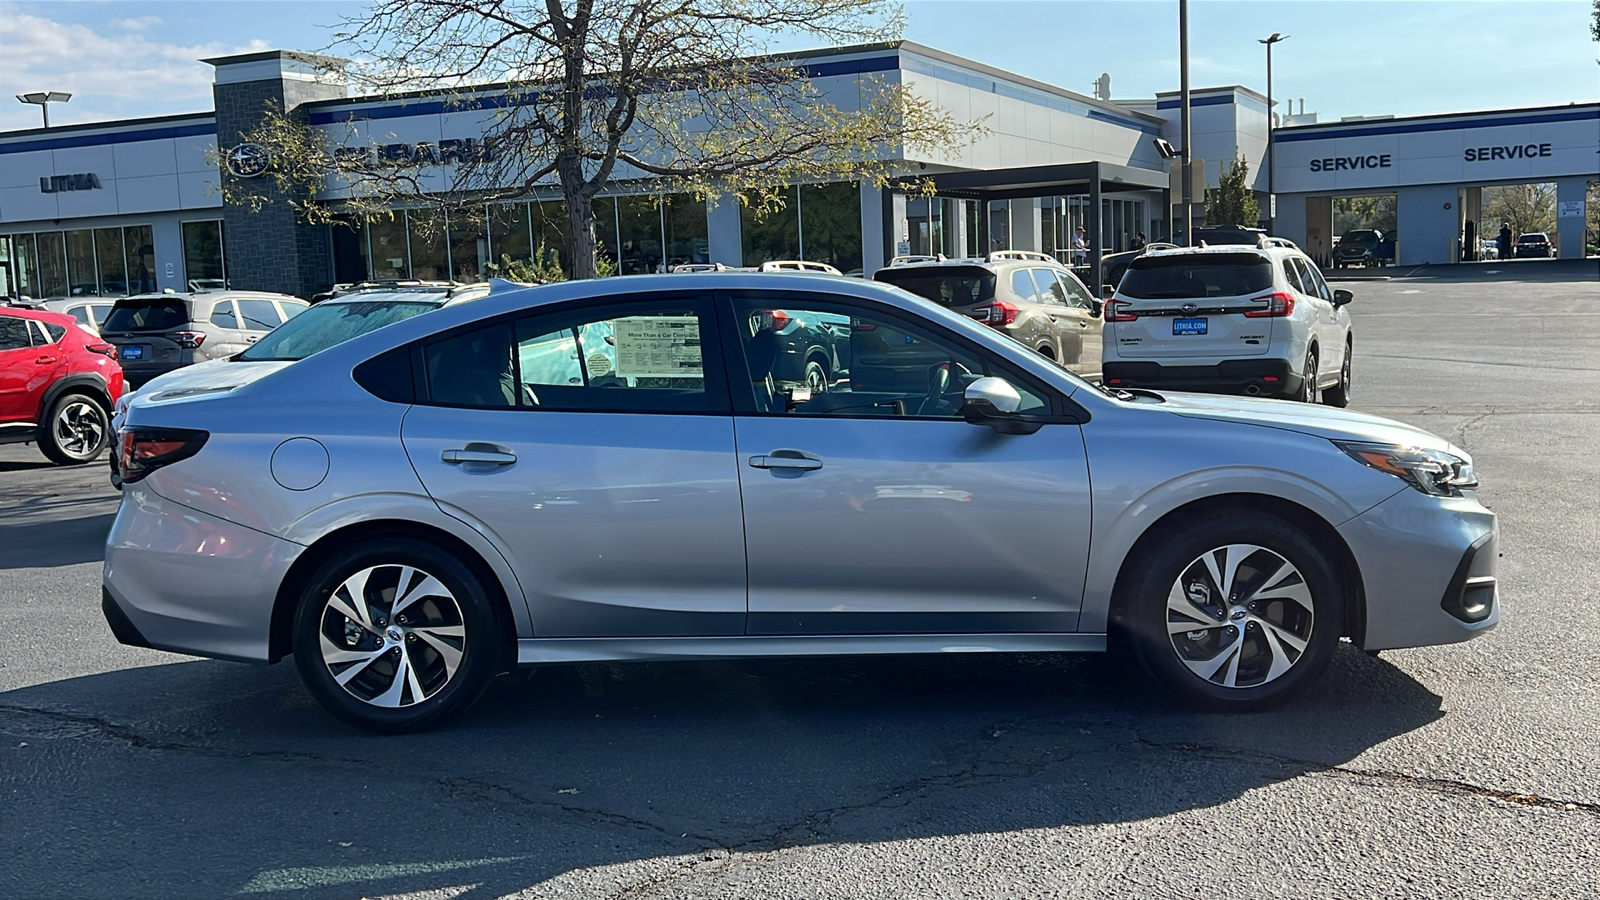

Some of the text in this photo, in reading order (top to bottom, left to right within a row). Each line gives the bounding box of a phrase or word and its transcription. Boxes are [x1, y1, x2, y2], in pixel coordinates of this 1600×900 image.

[1464, 143, 1552, 162] SERVICE
[1310, 154, 1391, 172] SERVICE
[40, 172, 102, 193] LITHIA
[1174, 322, 1206, 330] LITHIA.COM
